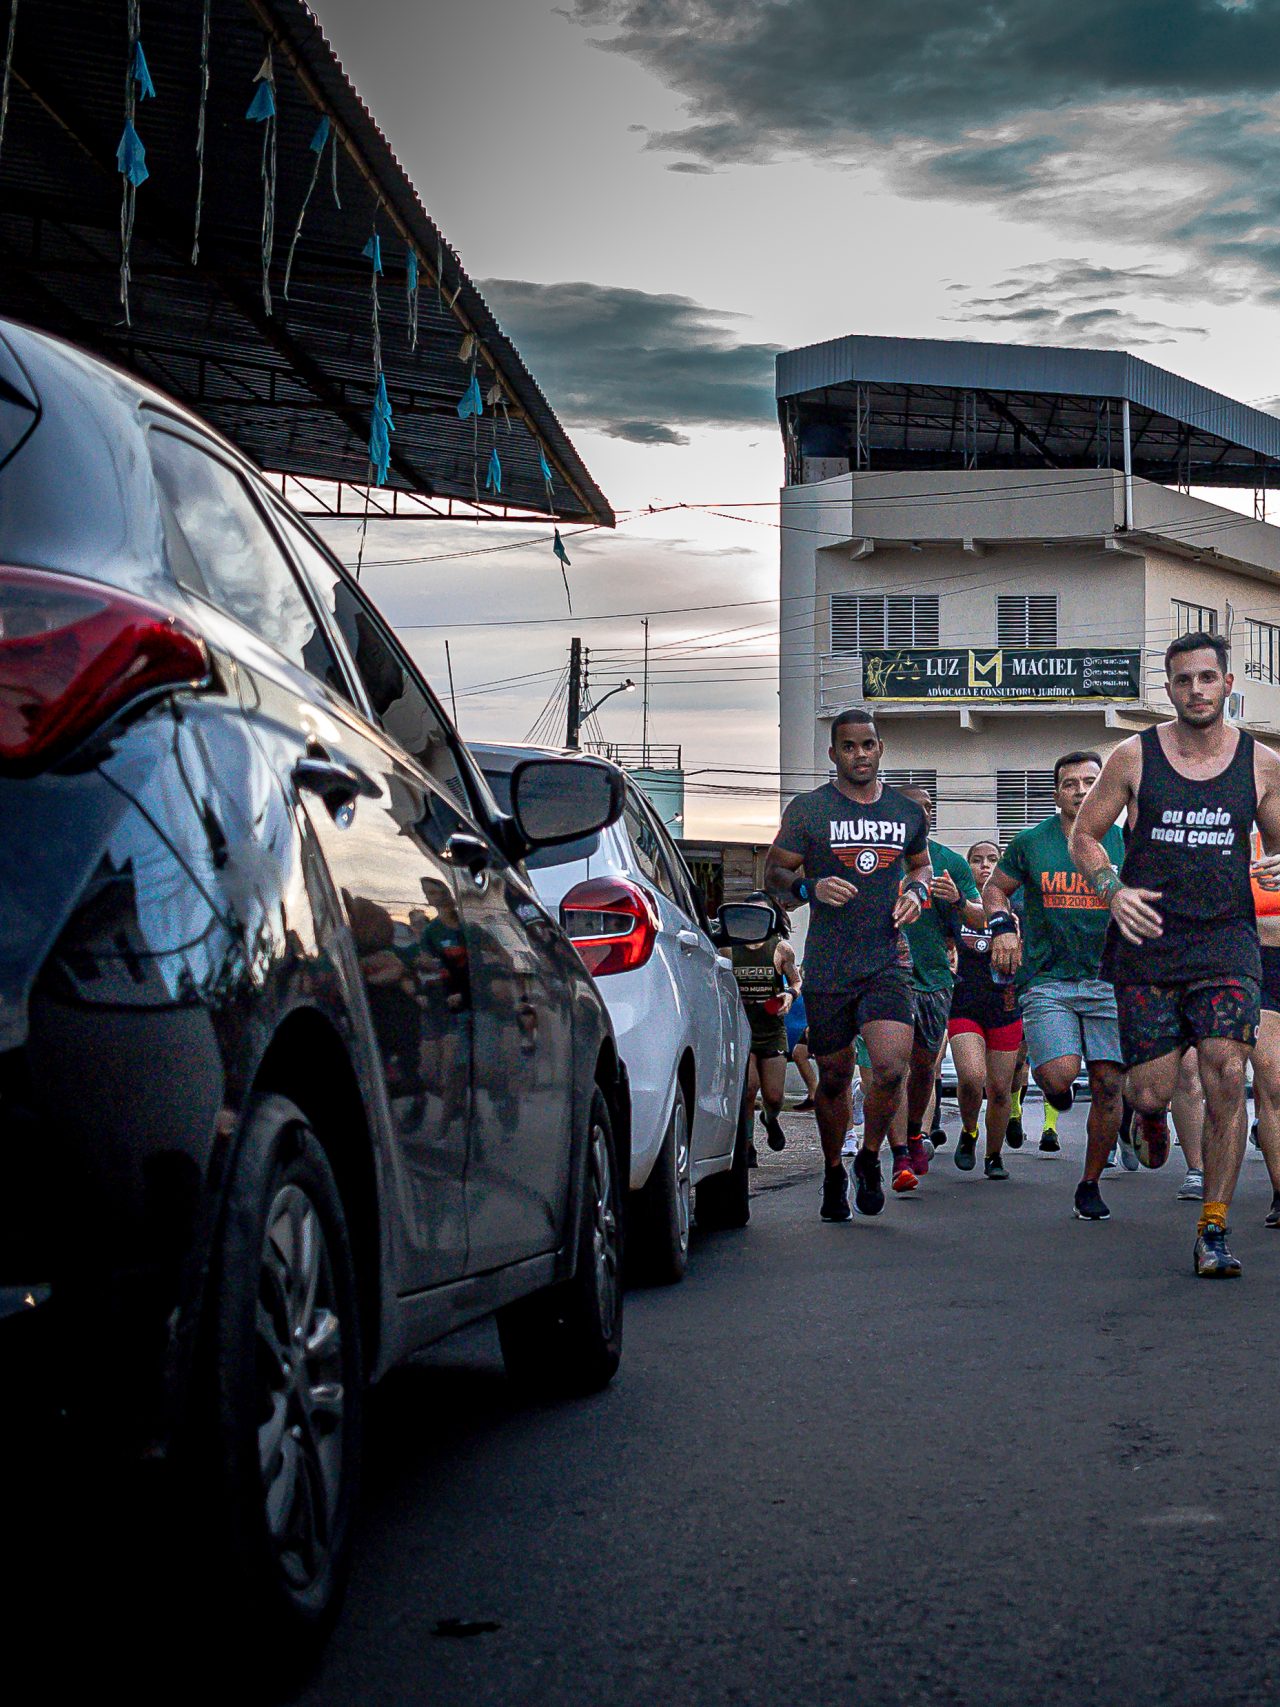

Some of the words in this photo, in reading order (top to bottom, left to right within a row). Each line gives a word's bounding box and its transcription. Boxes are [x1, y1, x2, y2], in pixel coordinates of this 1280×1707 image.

[926, 658, 959, 676] LUZ
[1012, 658, 1077, 676] MACIEL
[927, 686, 971, 697] ADVOCACIA
[974, 687, 979, 697] E
[980, 687, 1036, 697] CONSULTORIA
[1037, 685, 1075, 697] JURÍDICA
[1162, 810, 1183, 824] eu
[1186, 807, 1231, 826] odeio
[830, 818, 906, 844] MURPH
[1151, 827, 1185, 843] meu
[1187, 828, 1235, 846] coach
[1041, 871, 1096, 894] MUR
